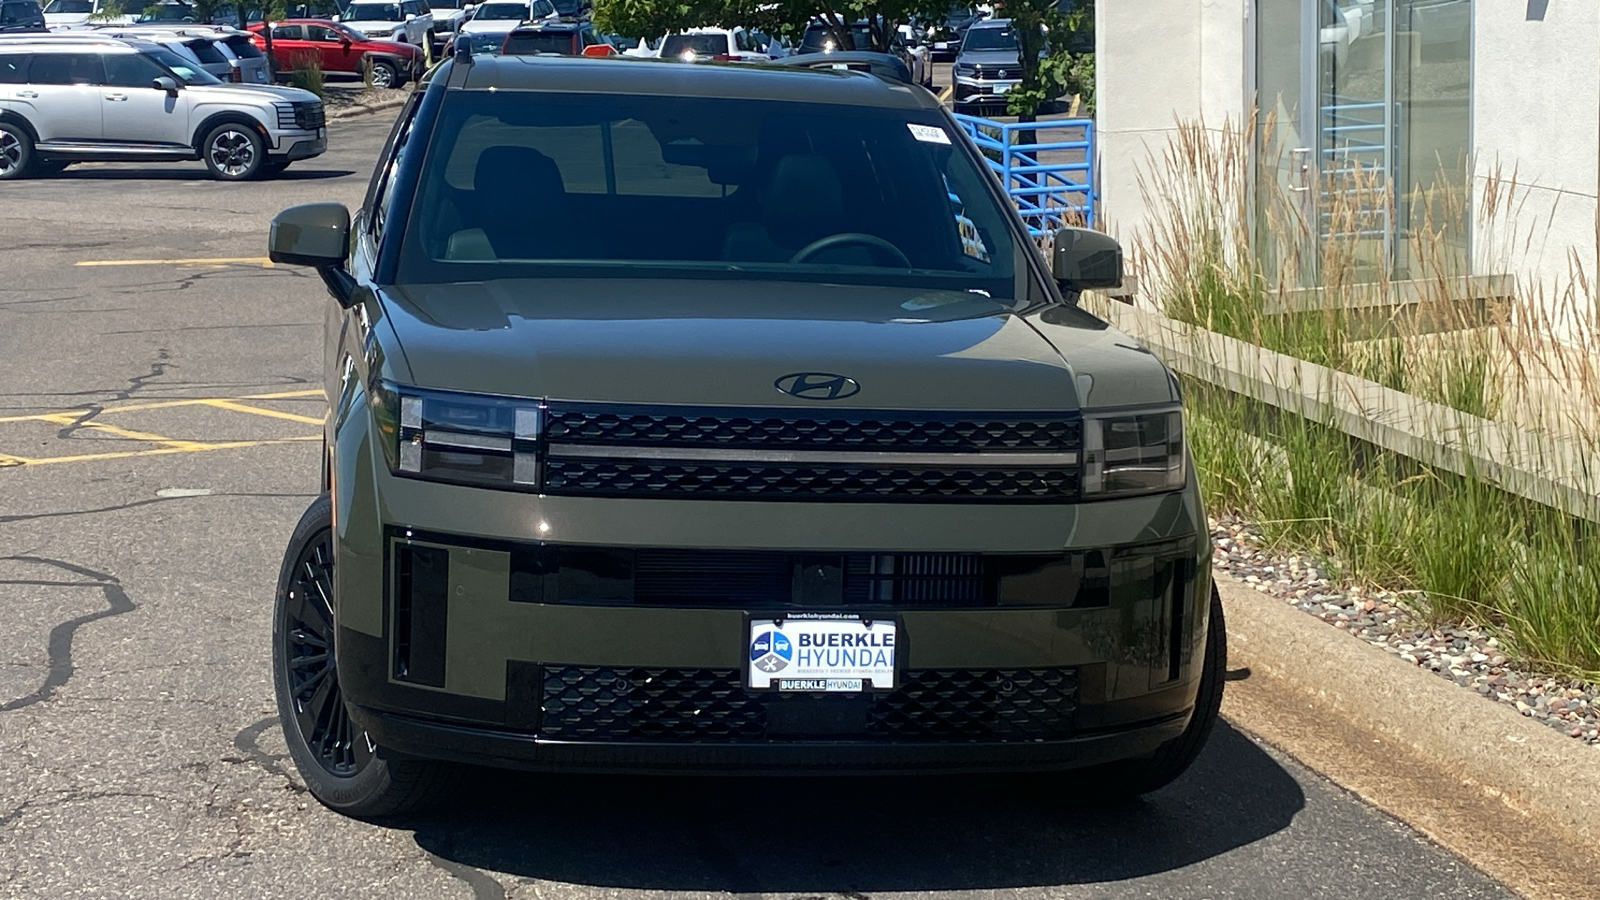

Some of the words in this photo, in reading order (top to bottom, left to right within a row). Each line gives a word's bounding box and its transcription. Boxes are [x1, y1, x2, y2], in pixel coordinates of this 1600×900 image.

[798, 633, 894, 647] BUERKLE
[797, 649, 893, 667] HYUNDAI
[781, 680, 825, 689] BUERKLE
[827, 680, 861, 689] HYUNDAI
